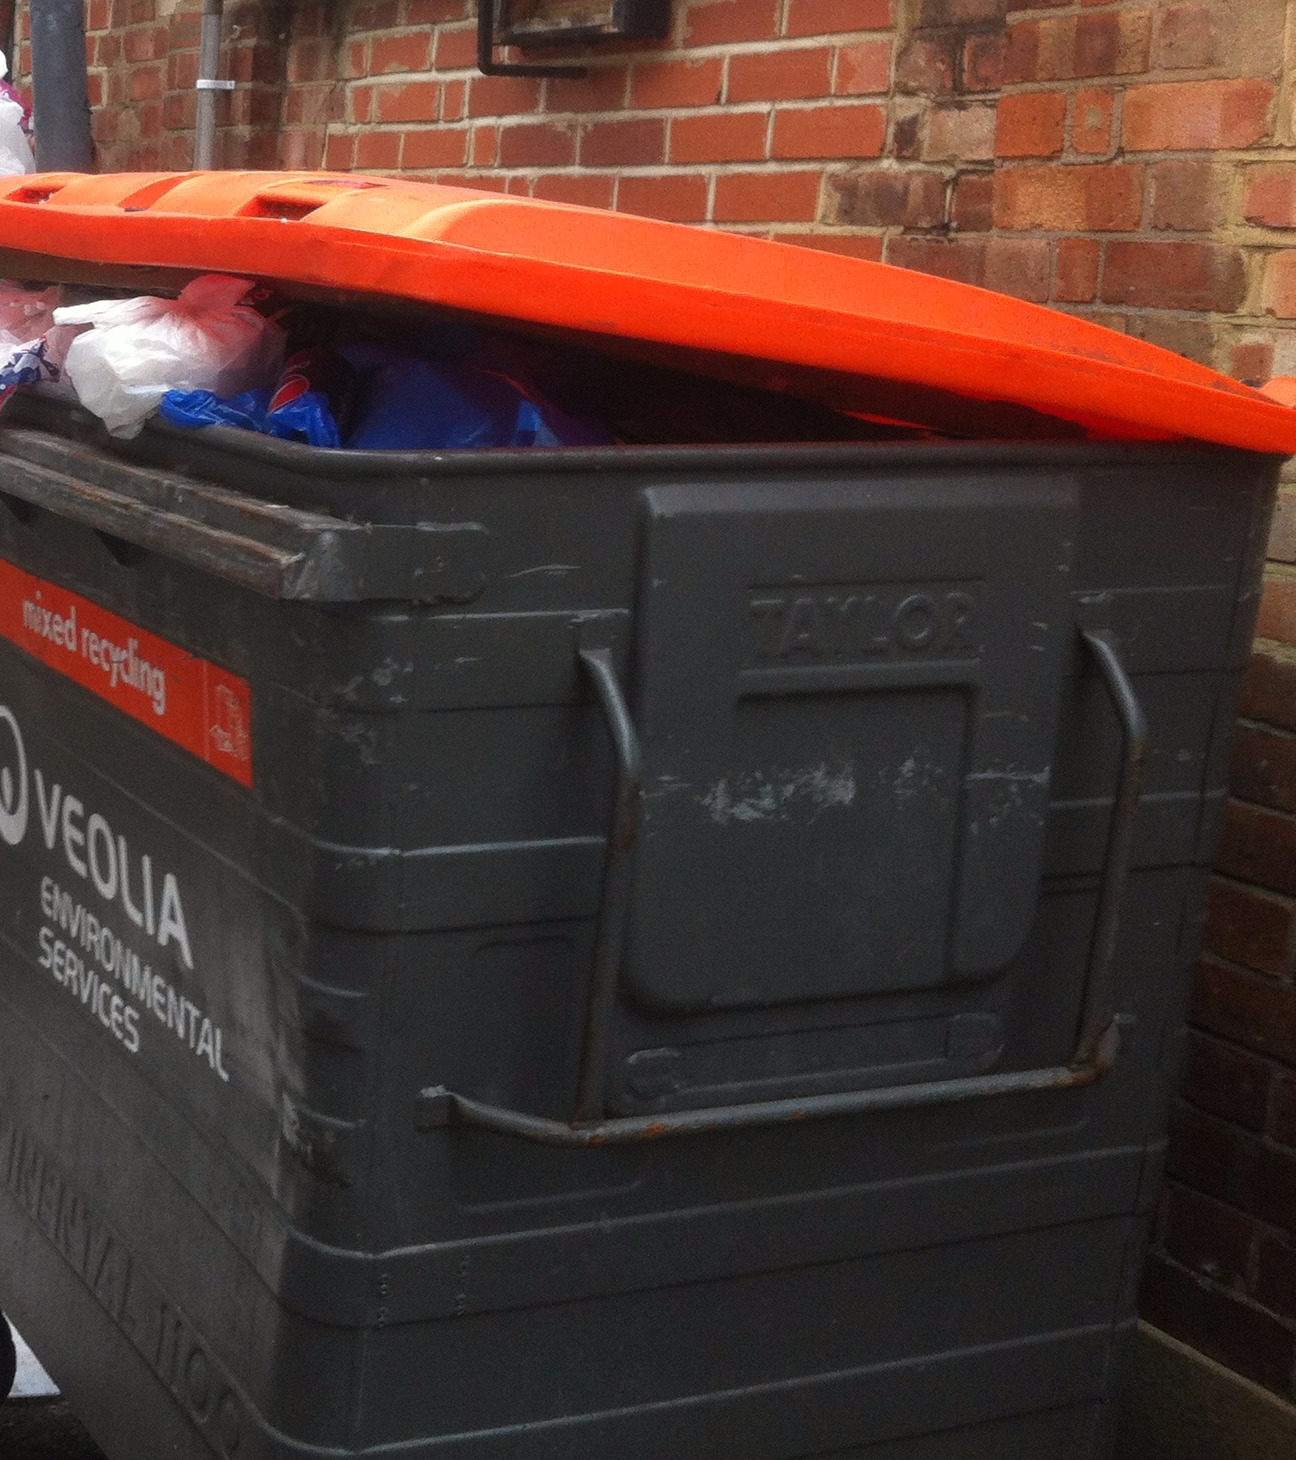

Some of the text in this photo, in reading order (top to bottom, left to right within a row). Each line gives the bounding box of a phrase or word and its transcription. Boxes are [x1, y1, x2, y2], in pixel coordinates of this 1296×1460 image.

[22, 590, 167, 716] mixed recycling
[748, 589, 978, 658] TAYLOR
[34, 768, 195, 971] VEOLIA
[37, 926, 140, 1053] SERVICES
[40, 875, 230, 1083] ENVIRONMENTAL
